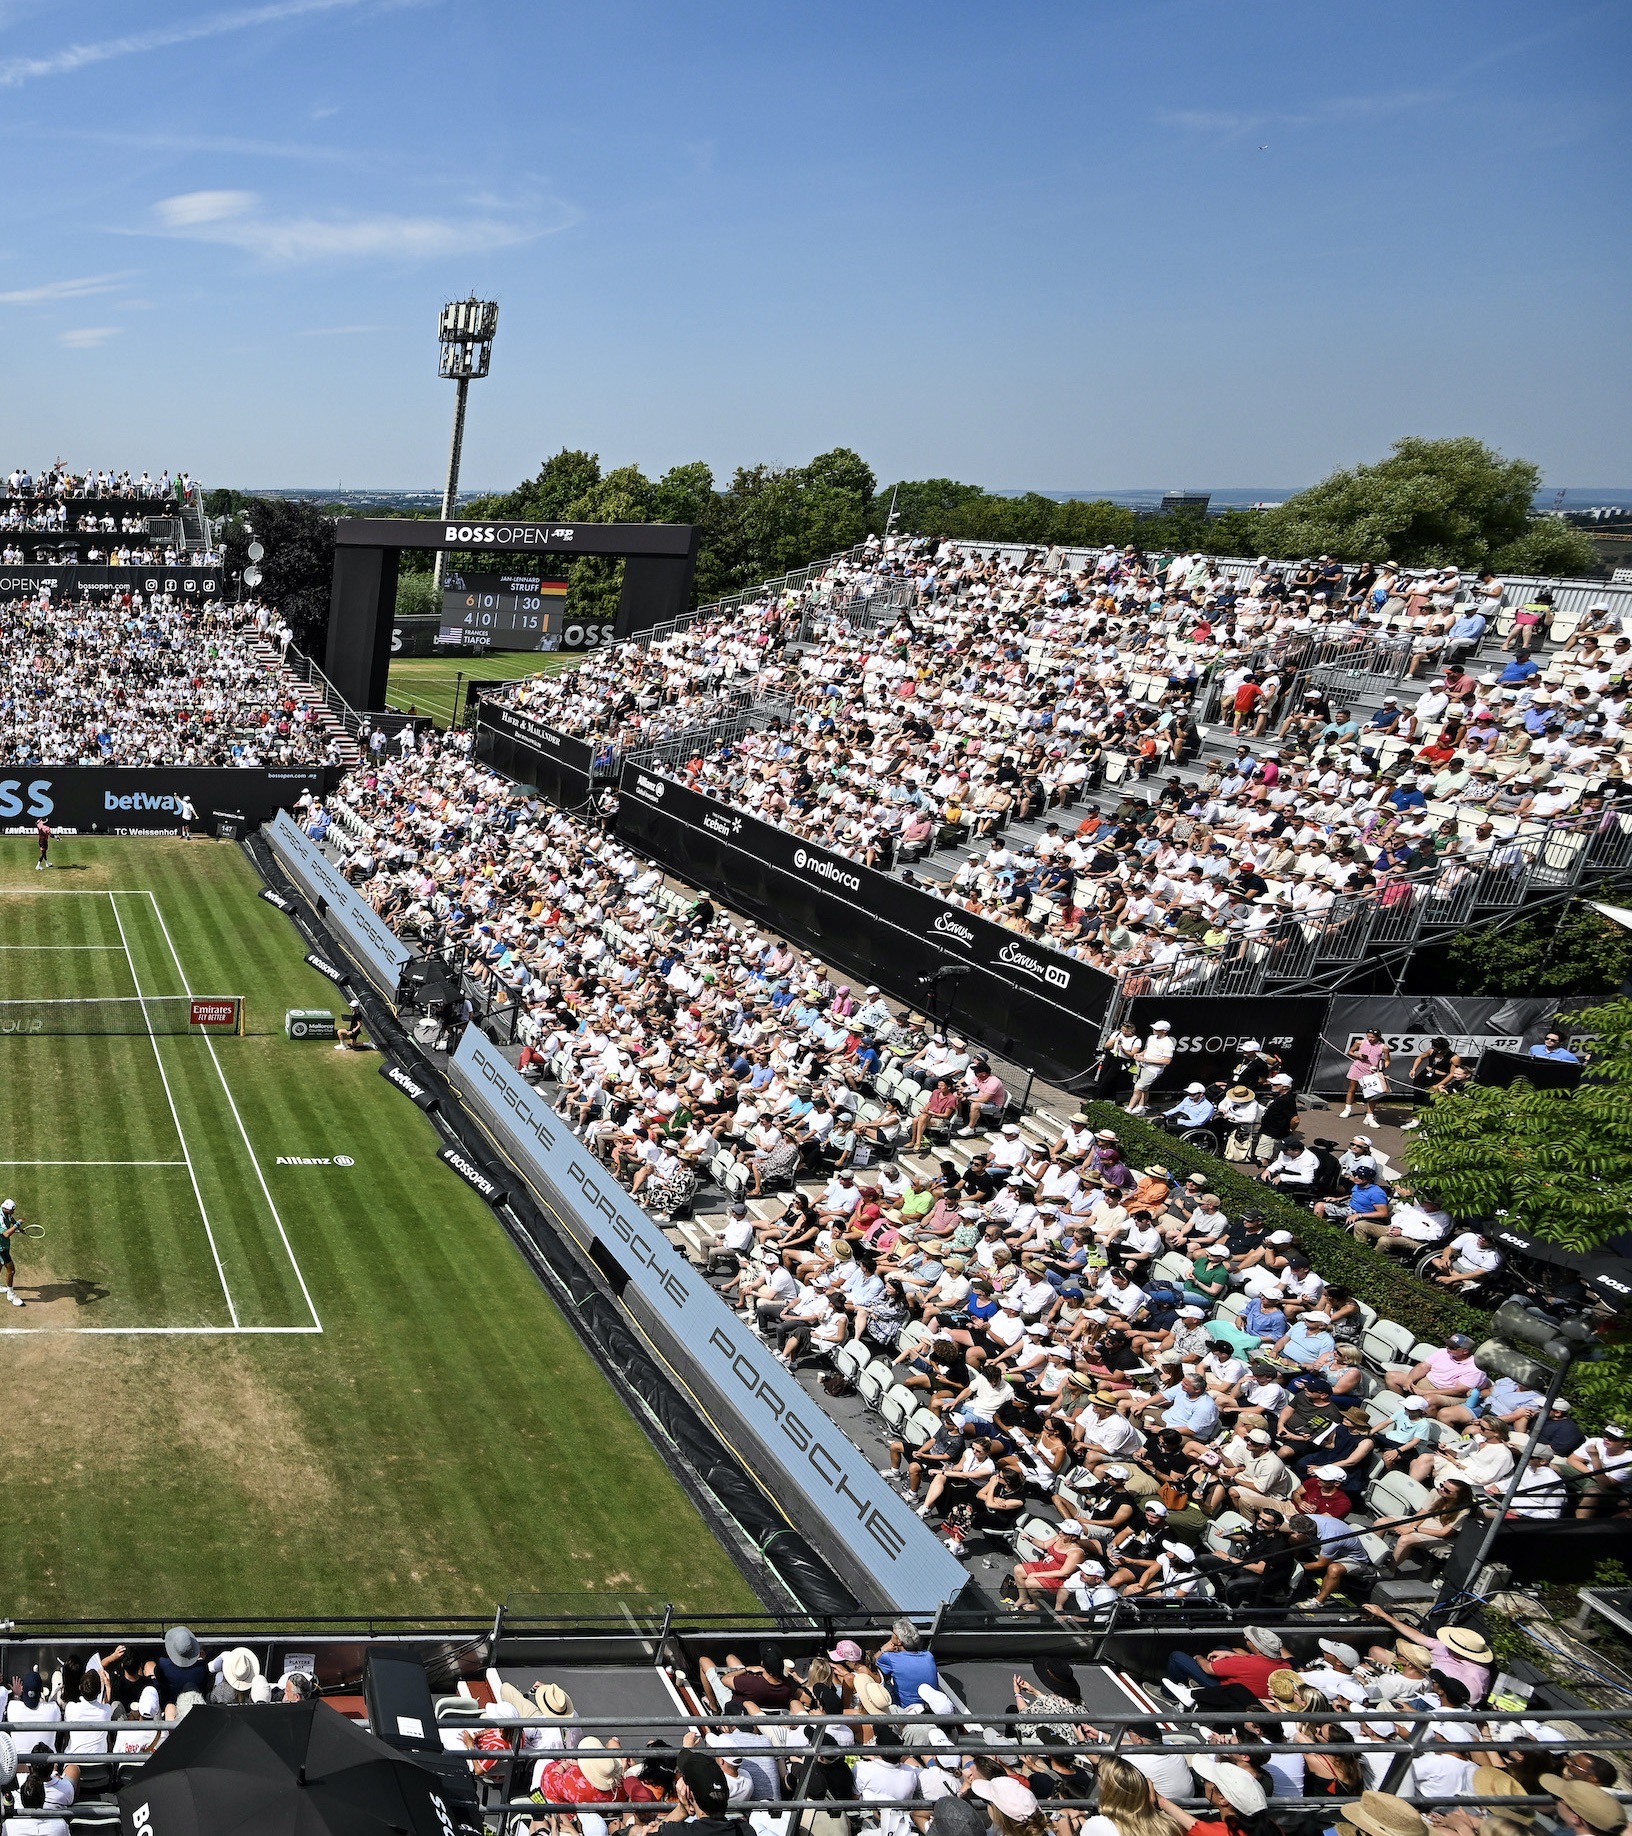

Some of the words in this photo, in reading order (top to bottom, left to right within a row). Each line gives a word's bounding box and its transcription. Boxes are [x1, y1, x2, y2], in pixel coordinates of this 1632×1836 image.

[445, 526, 495, 542] BOSS
[497, 528, 549, 544] OPEN
[551, 529, 574, 537] ATP
[0, 578, 40, 591] OPEN
[78, 581, 131, 592] bossopen.com
[510, 584, 540, 592] STRUFF
[466, 594, 475, 607] 6
[484, 595, 493, 608] 0
[522, 597, 541, 611] 30
[464, 612, 473, 625] 4
[482, 613, 491, 626] 0
[522, 615, 538, 629] 15
[464, 636, 491, 646] TIAFOE
[564, 624, 615, 646] OSS
[104, 791, 184, 816] betway
[5, 826, 39, 834] LAVAZZA
[115, 828, 127, 836] TC
[129, 828, 178, 836] Weissenhof
[703, 814, 730, 836] icebein
[279, 822, 309, 860] PORSCHE
[807, 857, 861, 891] mallorca
[310, 861, 348, 907] PORSCHE
[264, 890, 288, 908] betway
[351, 908, 396, 965] PORSCHE
[308, 954, 341, 980] #BOSSOPEN
[192, 1004, 232, 1014] Emirates
[198, 1013, 207, 1021] FLY
[208, 1013, 226, 1021] BETTER
[1168, 1036, 1204, 1052] OSS
[1268, 1036, 1294, 1045] ATP
[1491, 1039, 1517, 1047] ATP
[389, 1068, 424, 1098] betway
[470, 1048, 554, 1151] PORSCHE
[276, 1157, 331, 1165] Allianz
[443, 1149, 495, 1194] #BOSSOPEN
[566, 1161, 690, 1308] PORSCHE
[1499, 1232, 1531, 1249] BOSS
[1596, 1274, 1632, 1294] BOSS
[708, 1327, 907, 1561] PORSCHE
